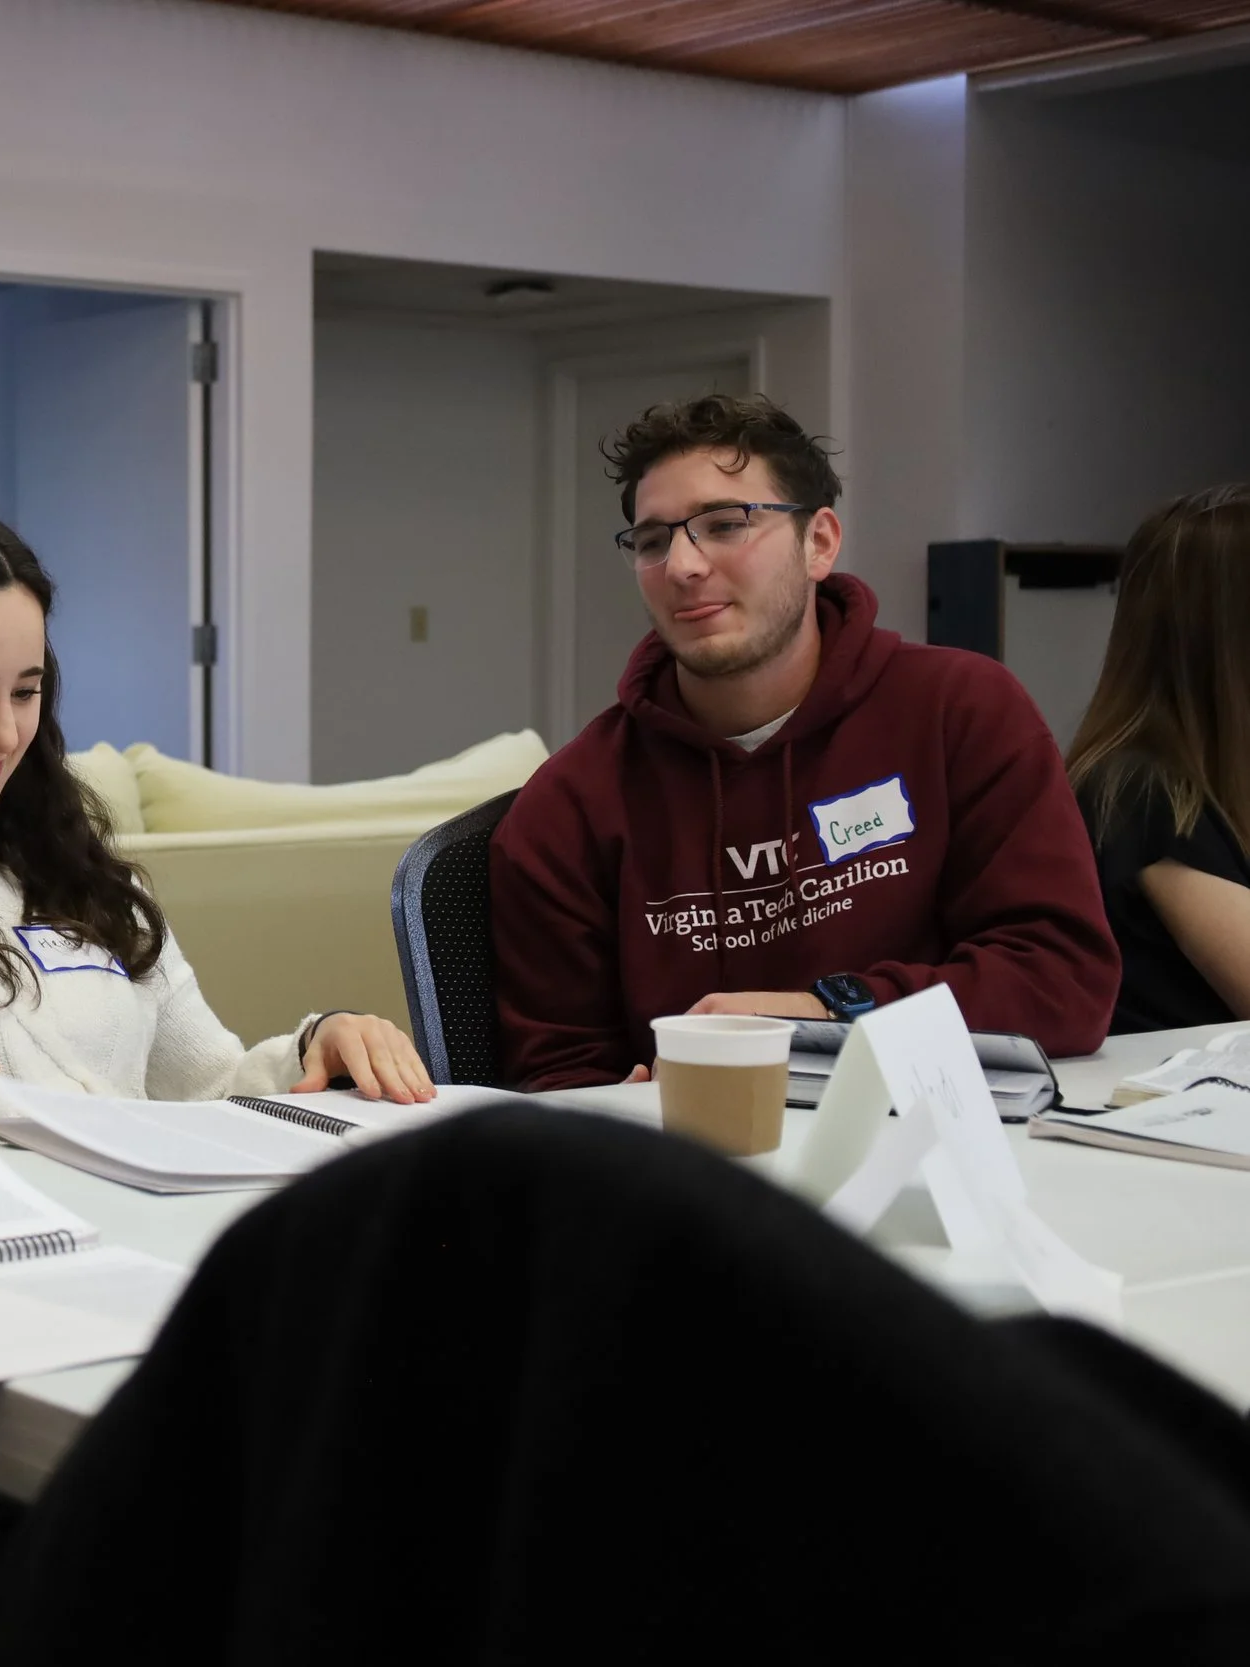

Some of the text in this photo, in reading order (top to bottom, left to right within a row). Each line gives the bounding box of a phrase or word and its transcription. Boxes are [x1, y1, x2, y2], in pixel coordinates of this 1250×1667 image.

[830, 811, 884, 846] Creed
[645, 856, 910, 936] Virgina Tech Carilion
[761, 925, 776, 943] of
[776, 896, 853, 936] Medicine
